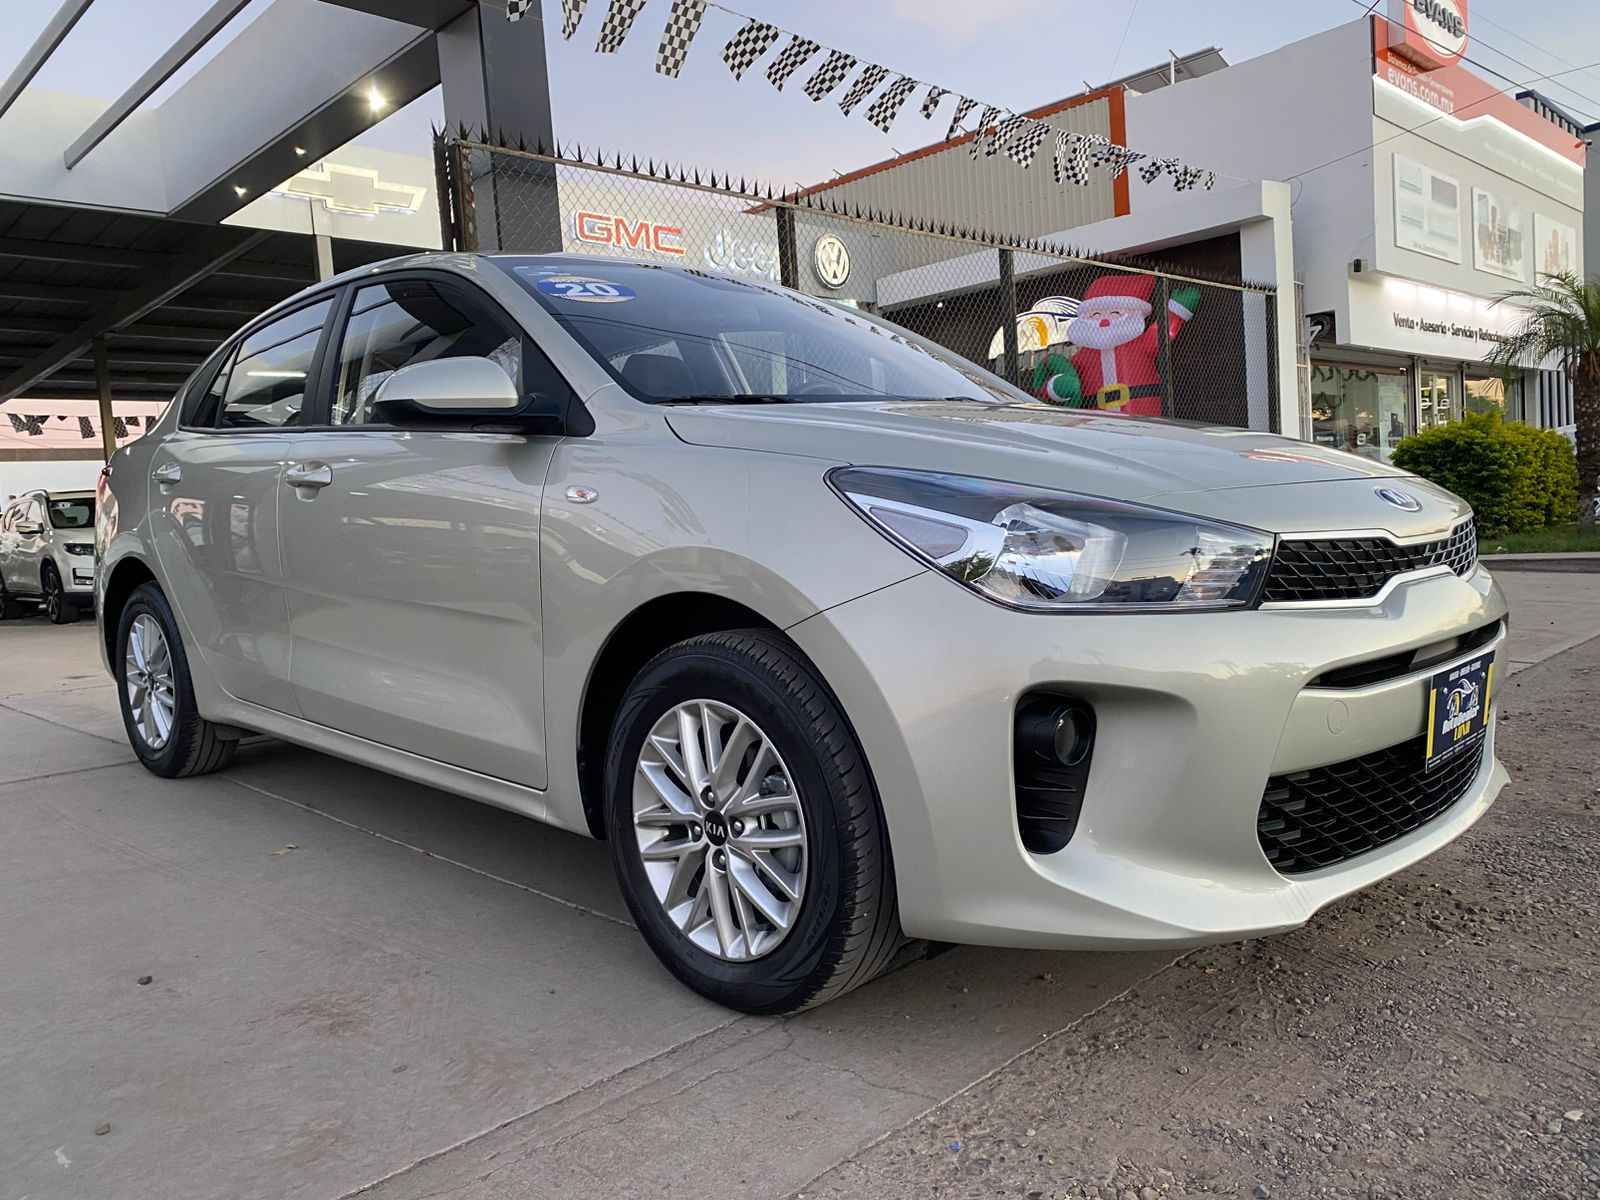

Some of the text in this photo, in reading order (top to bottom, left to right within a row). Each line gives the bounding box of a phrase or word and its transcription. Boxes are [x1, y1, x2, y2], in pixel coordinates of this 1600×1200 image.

[1413, 0, 1465, 38] EVANS
[576, 210, 687, 257] GMC
[554, 282, 620, 297] 20
[1392, 311, 1415, 330] Venta
[1451, 322, 1474, 339] Servicio
[705, 820, 726, 839] KIA
